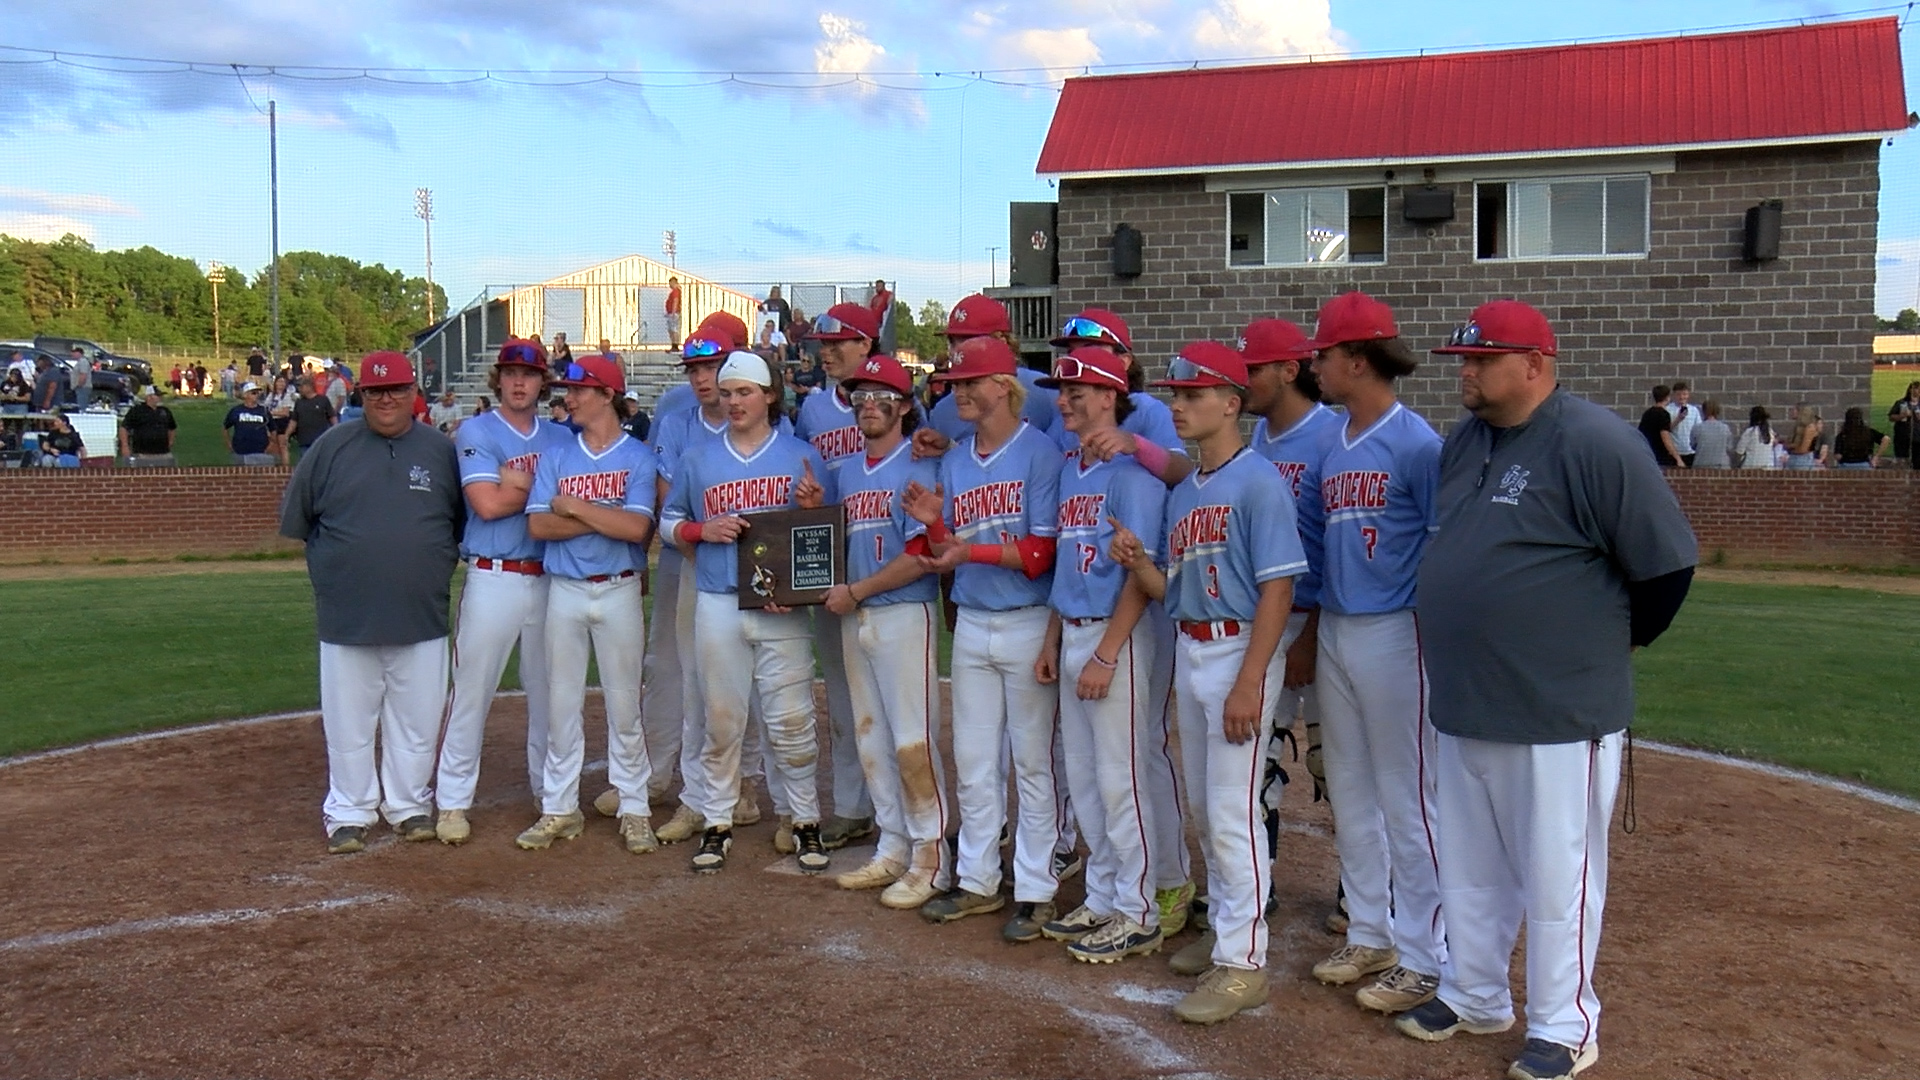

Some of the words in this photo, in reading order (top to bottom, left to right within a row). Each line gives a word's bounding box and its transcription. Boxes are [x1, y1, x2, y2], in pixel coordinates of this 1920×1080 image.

[809, 424, 867, 462] EPENDE
[796, 529, 829, 538] WVSSAC
[874, 533, 885, 563] 1
[1361, 525, 1379, 562] 7
[796, 553, 829, 563] BASEBALL
[796, 568, 829, 578] REGIONAL
[1075, 542, 1098, 575] 17
[795, 576, 830, 586] CHAMPION
[1206, 563, 1221, 600] 3
